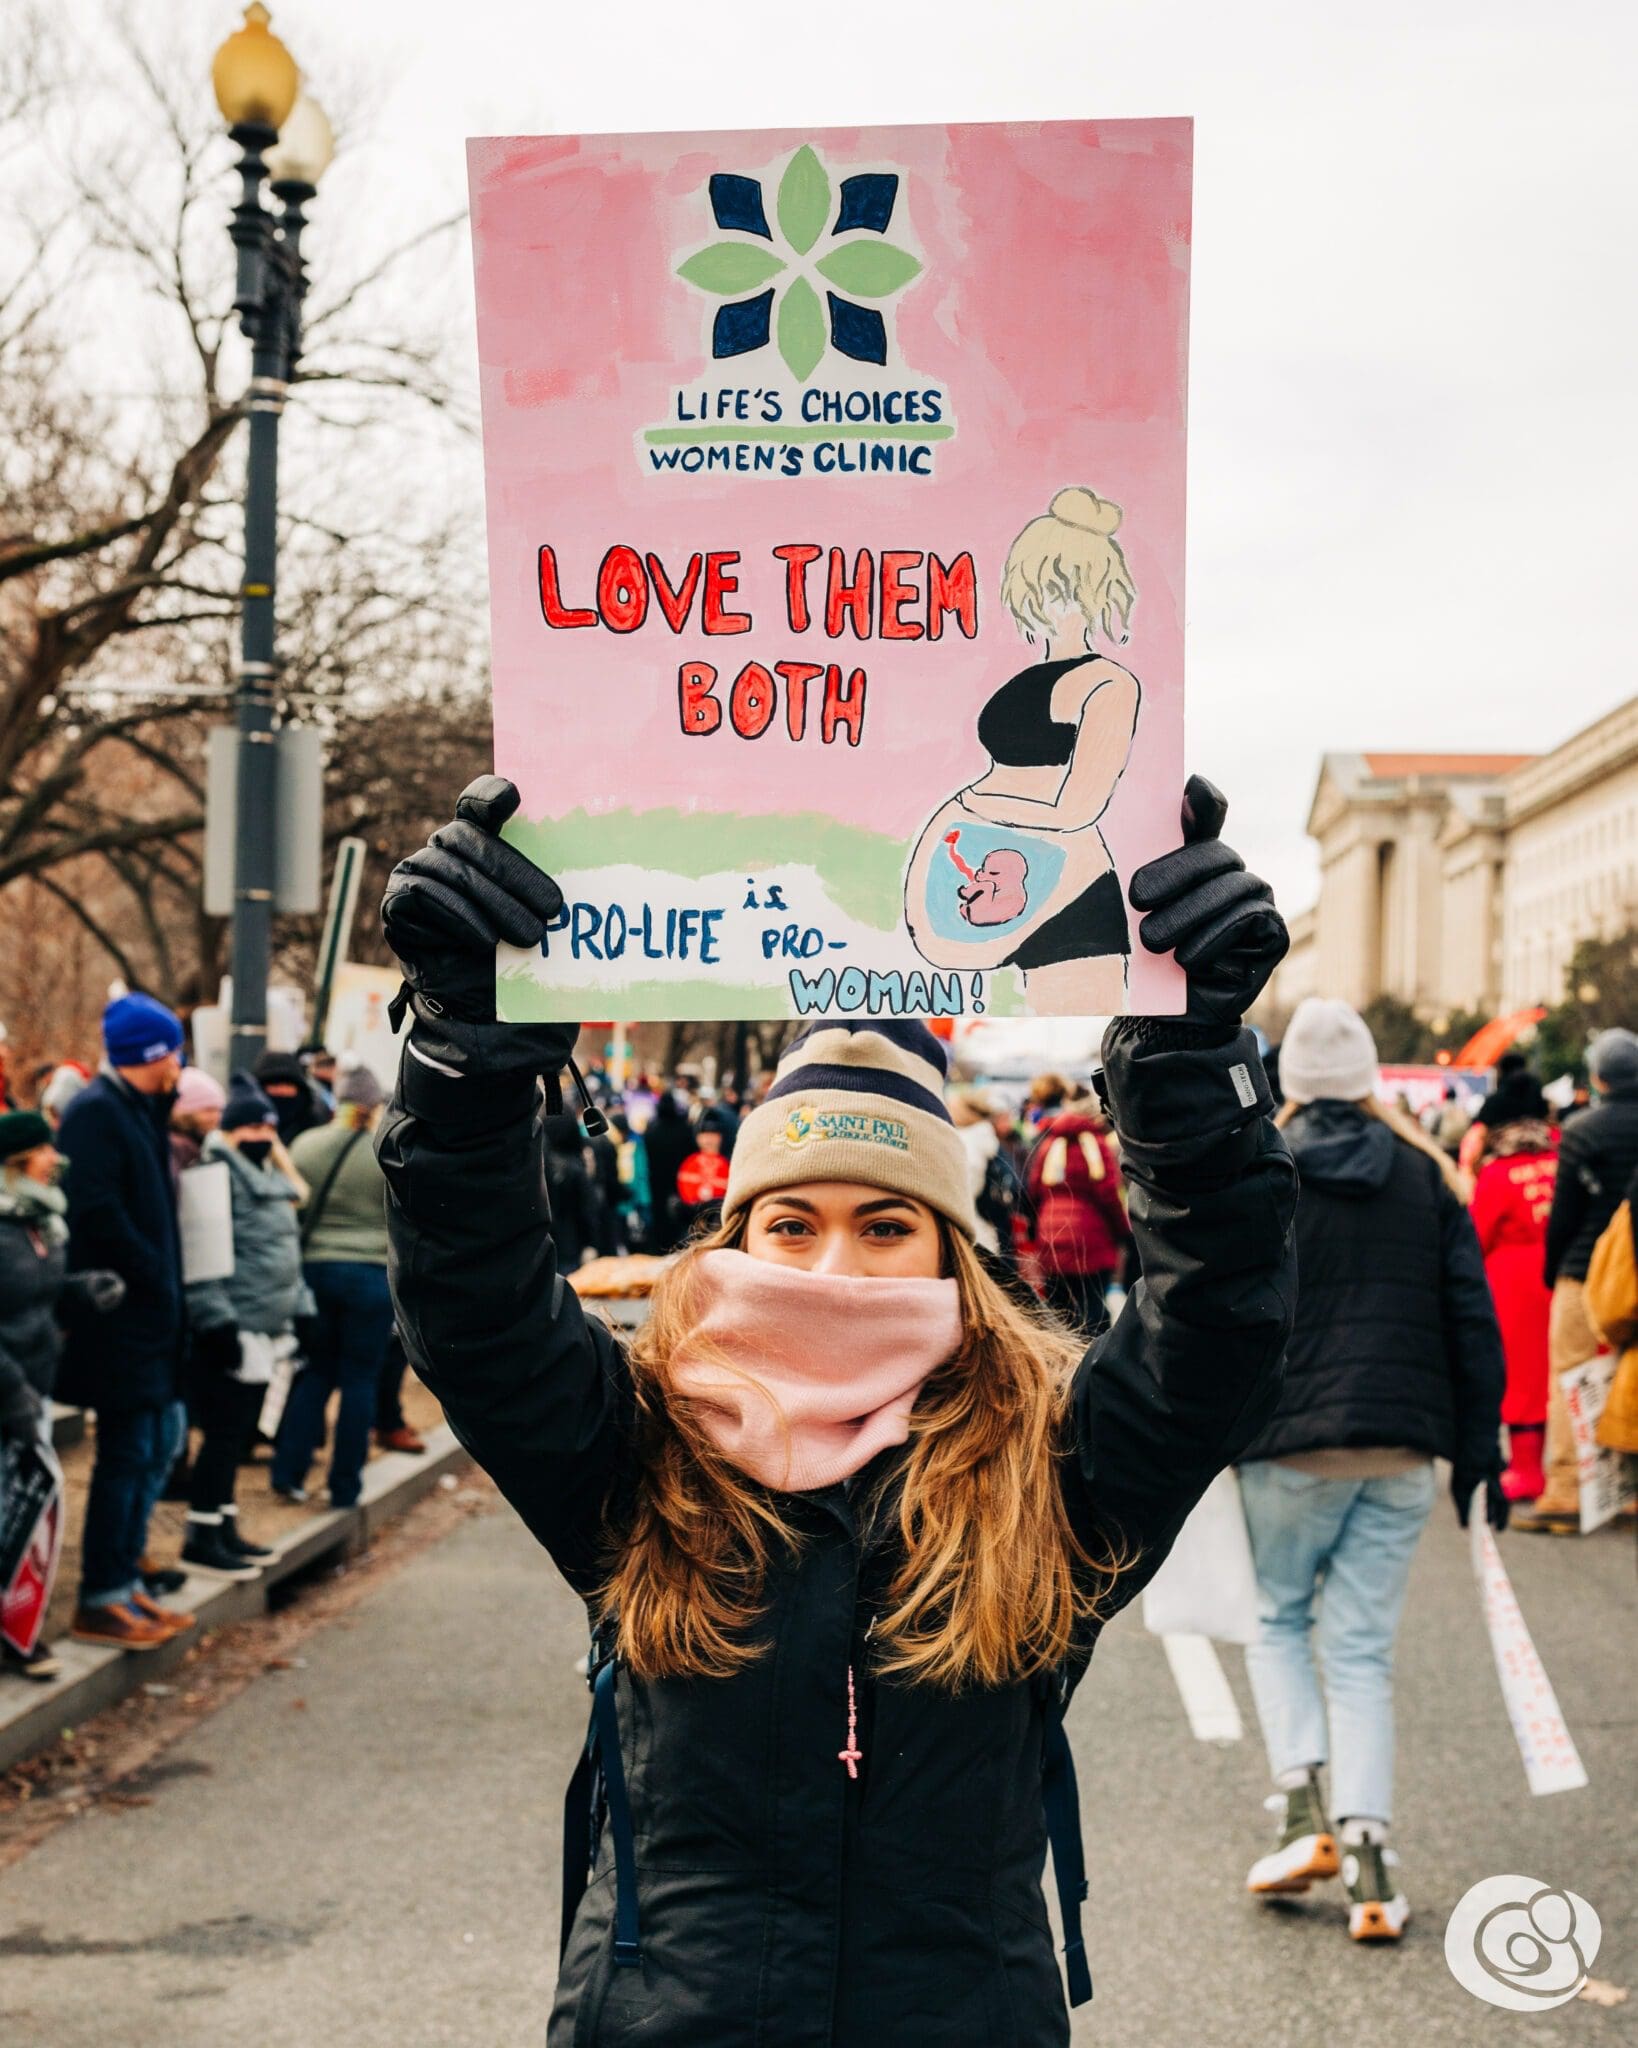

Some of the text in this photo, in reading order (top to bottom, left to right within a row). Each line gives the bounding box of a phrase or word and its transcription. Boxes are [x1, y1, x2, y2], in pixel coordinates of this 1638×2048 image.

[677, 388, 943, 423] LIFE'S CHOICES
[650, 441, 934, 475] WOMEN'S CLINIC
[538, 544, 978, 641] LOVE THEM
[678, 660, 867, 747] BOTH
[540, 879, 788, 964] PRO-LIFE is
[761, 923, 848, 960] PRO-
[789, 965, 985, 1015] WOMAN!
[814, 1114, 909, 1139] SAINT PAUL
